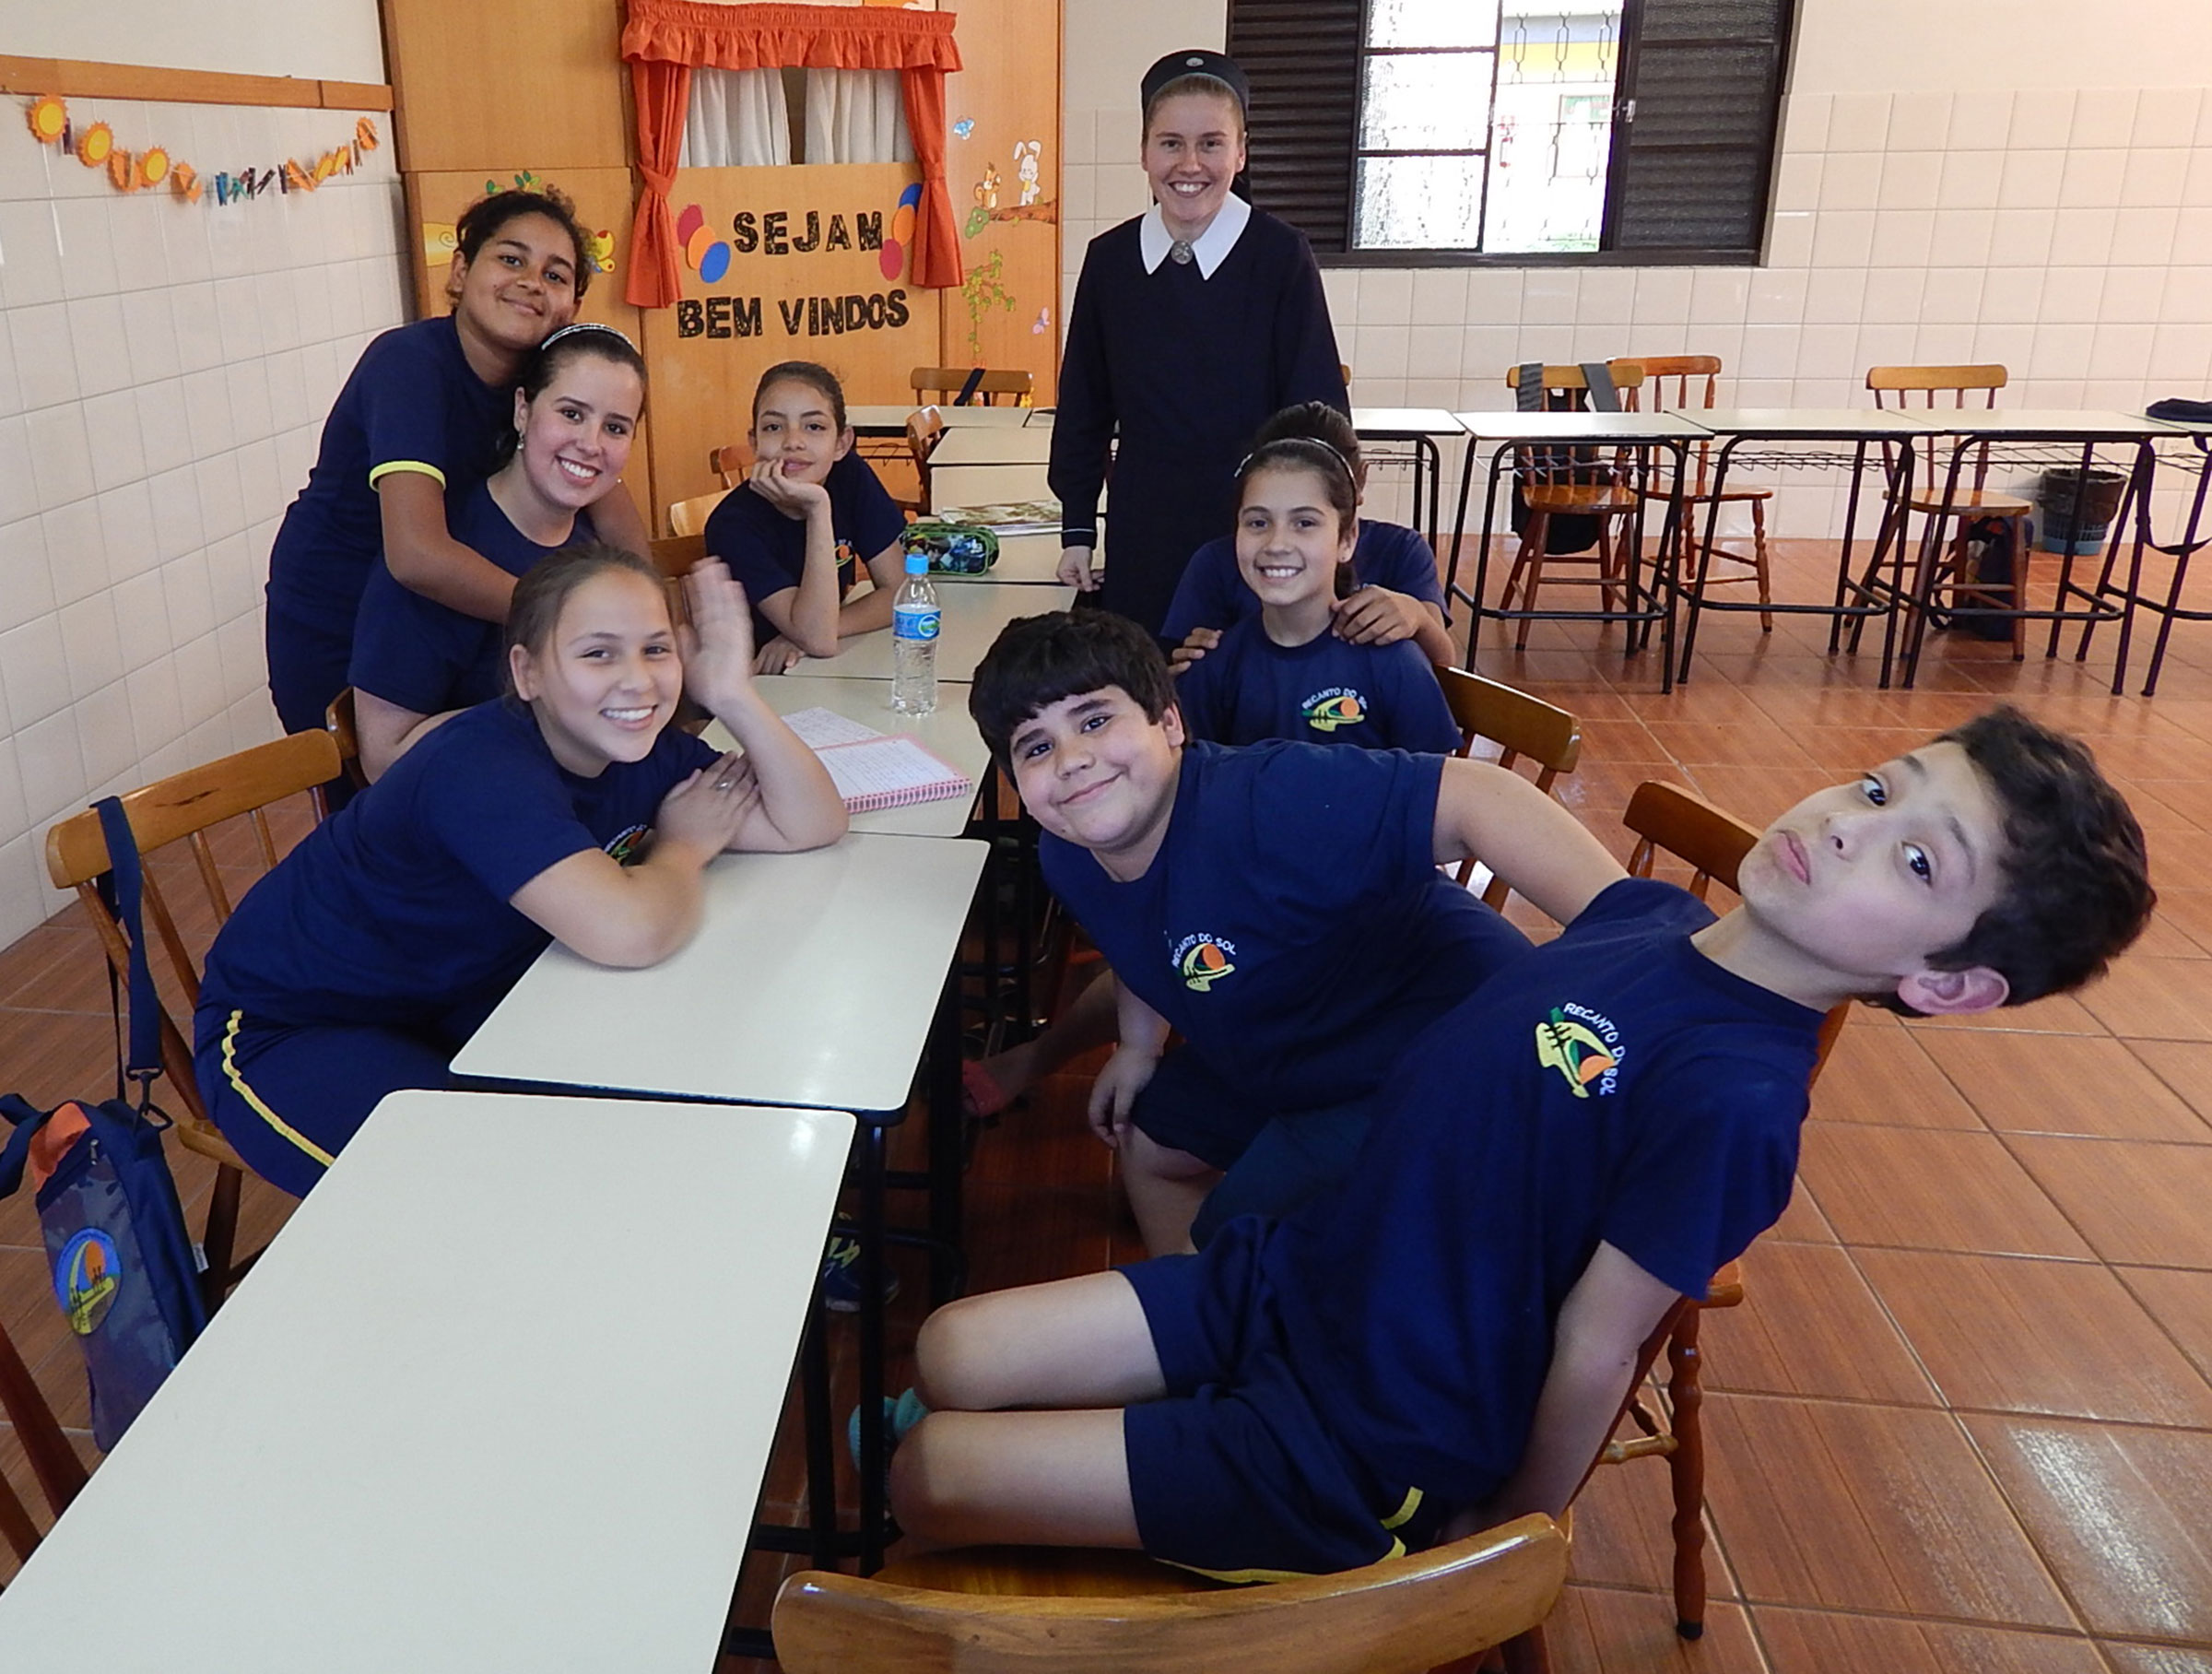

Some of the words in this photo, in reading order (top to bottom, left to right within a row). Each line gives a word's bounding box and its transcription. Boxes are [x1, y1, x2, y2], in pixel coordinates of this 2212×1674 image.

[733, 211, 883, 255] SEJAM
[677, 296, 763, 339] BEM
[778, 289, 910, 336] VINDOS
[1343, 688, 1358, 698] DO
[1197, 933, 1213, 943] DO
[1216, 937, 1236, 955] SOL
[1563, 1002, 1619, 1043] RECANTO
